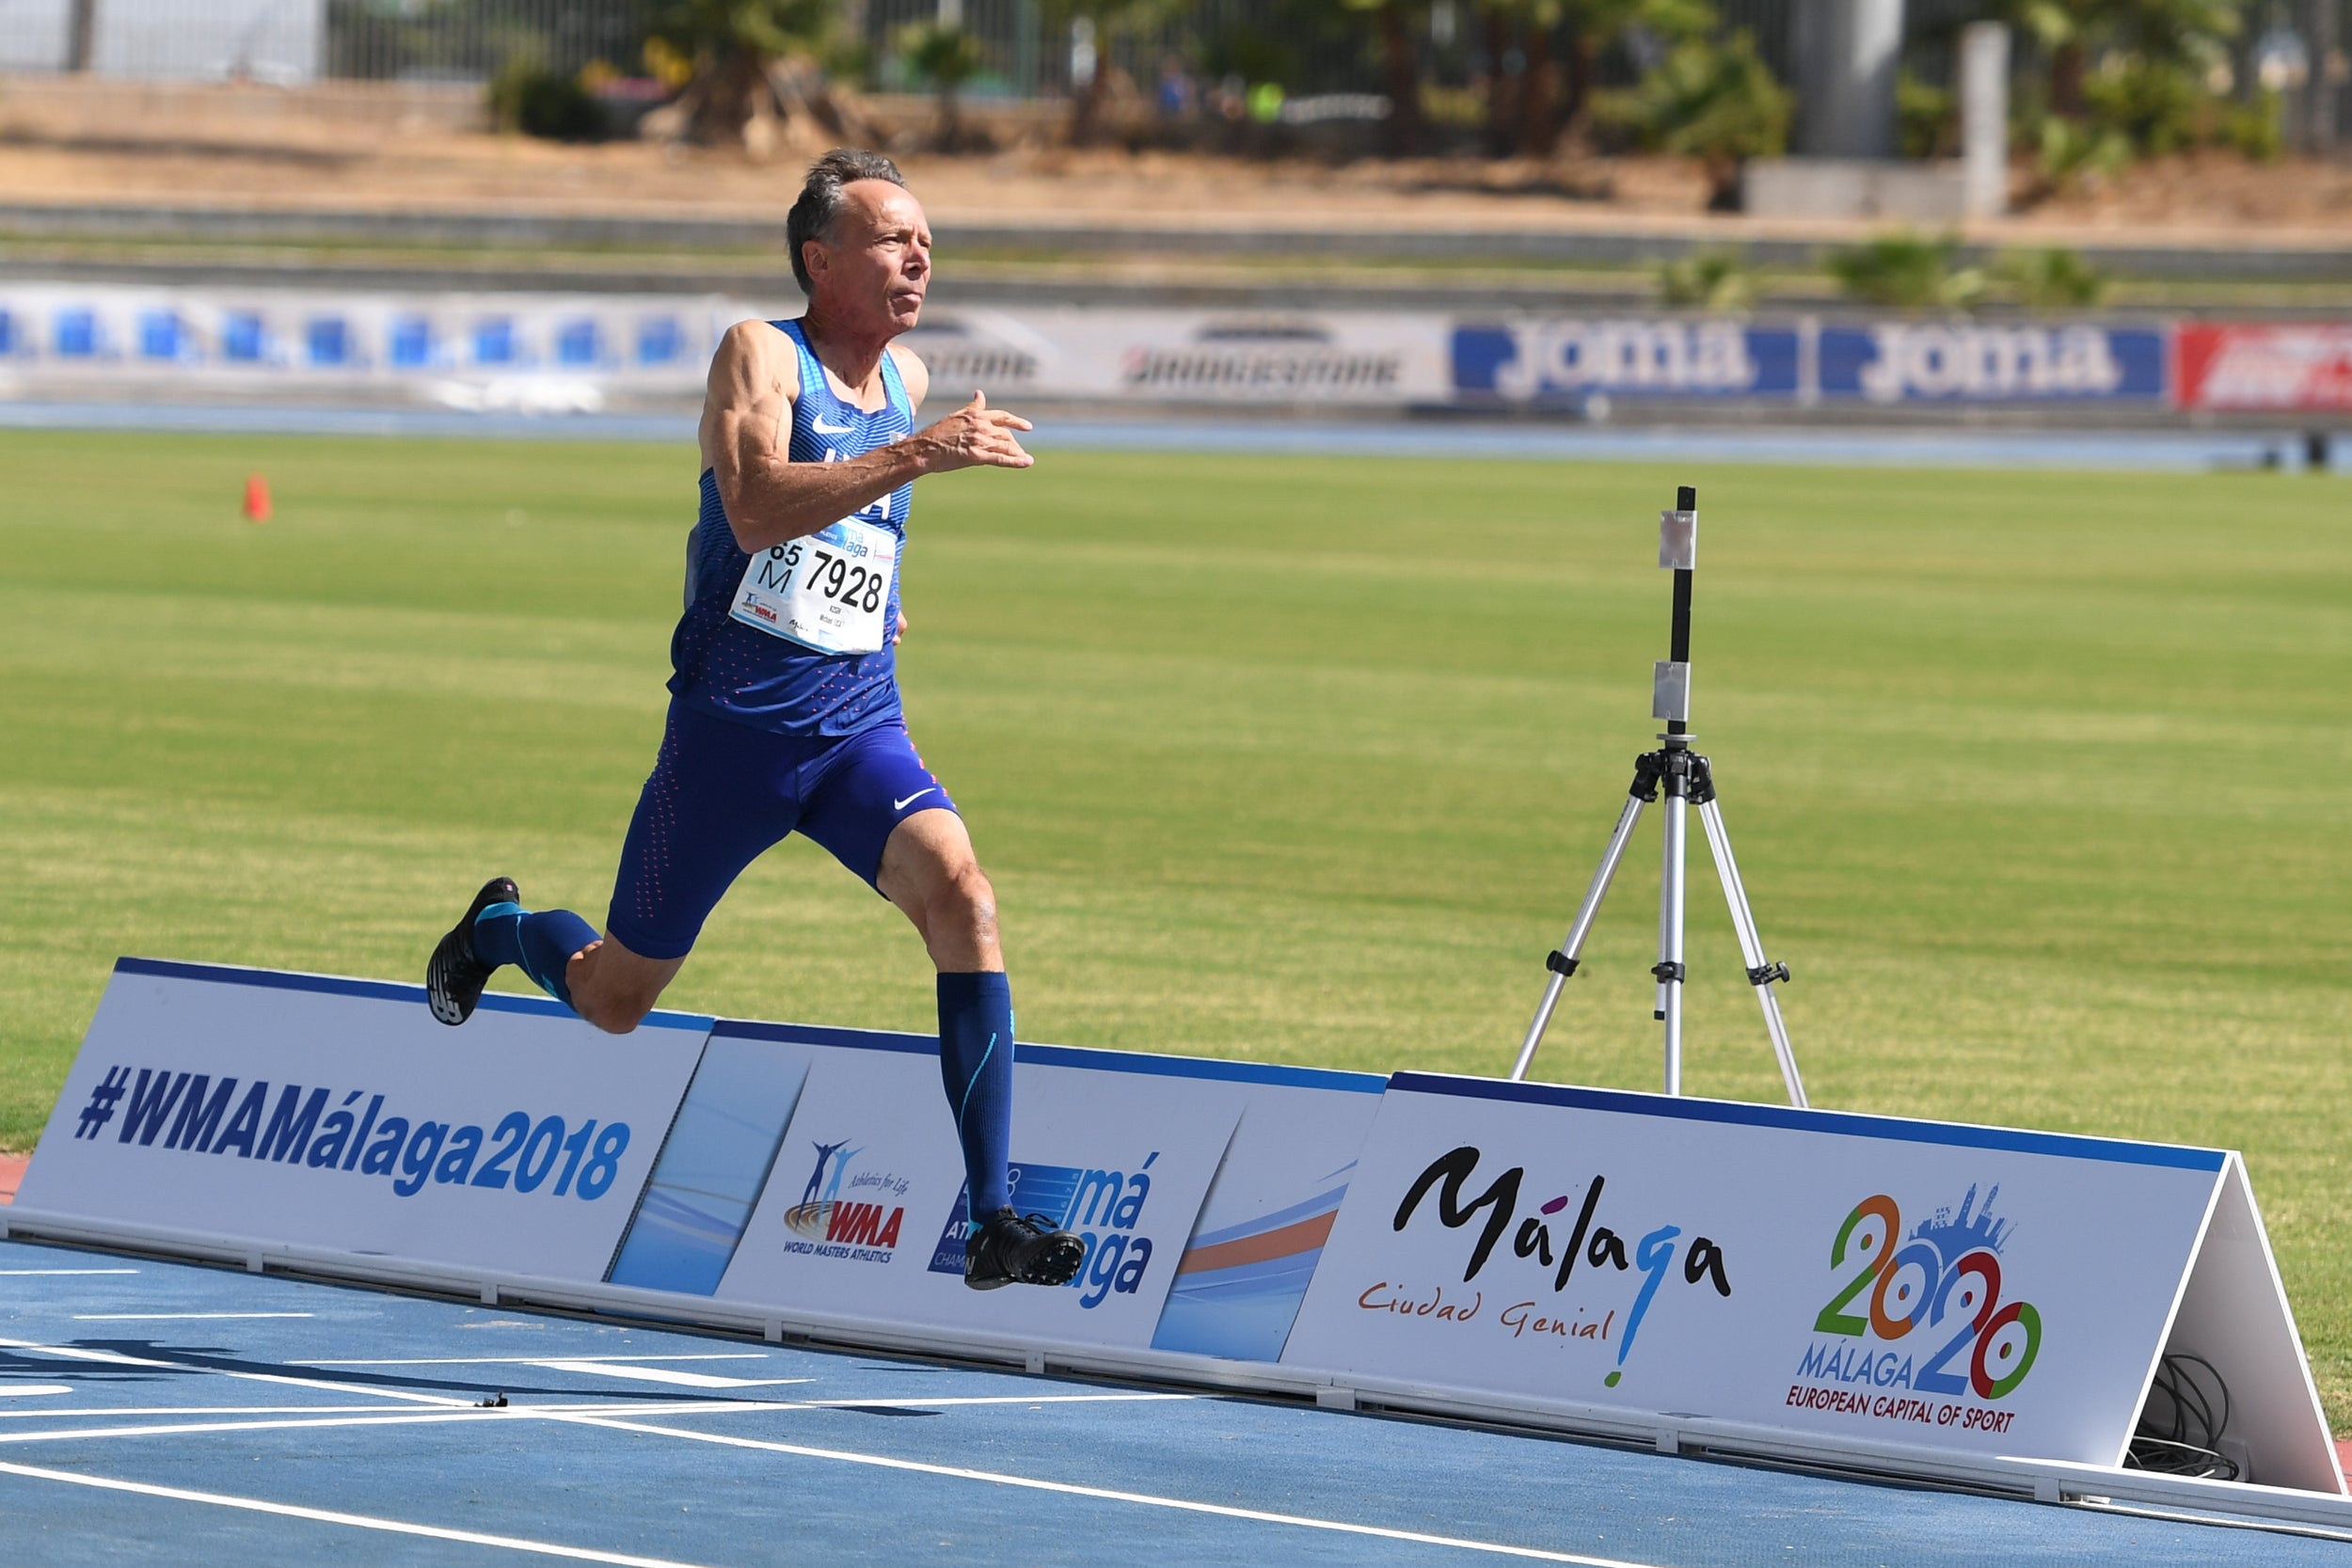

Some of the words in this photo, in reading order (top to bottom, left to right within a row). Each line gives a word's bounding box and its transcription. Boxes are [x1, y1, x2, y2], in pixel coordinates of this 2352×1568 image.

[757, 560, 792, 594] M
[770, 542, 803, 566] 65
[805, 549, 882, 613] 7928
[754, 605, 777, 622] WMA
[73, 1065, 631, 1201] #WMAMálaga2018
[848, 1172, 882, 1189] Athletics
[878, 1173, 895, 1191] for
[892, 1177, 910, 1196] Life
[1062, 1151, 1160, 1231] má
[825, 1200, 905, 1248] WMA
[783, 1241, 815, 1255] WORLD
[813, 1244, 851, 1259] MASTERS
[850, 1248, 893, 1264] ATHLETICS
[1063, 1231, 1152, 1309] ga
[1392, 1146, 1732, 1388] Málaga
[1358, 1281, 1482, 1322] Ciudad
[1500, 1301, 1615, 1339] Genial
[1812, 1194, 2042, 1401] 2020
[1795, 1338, 1914, 1390] MÁLAGA
[1785, 1385, 1871, 1417] EUROPEAN
[1872, 1396, 1934, 1424] CAPITAL
[1936, 1403, 1963, 1427] OF
[1962, 1407, 2015, 1433] SPORT
